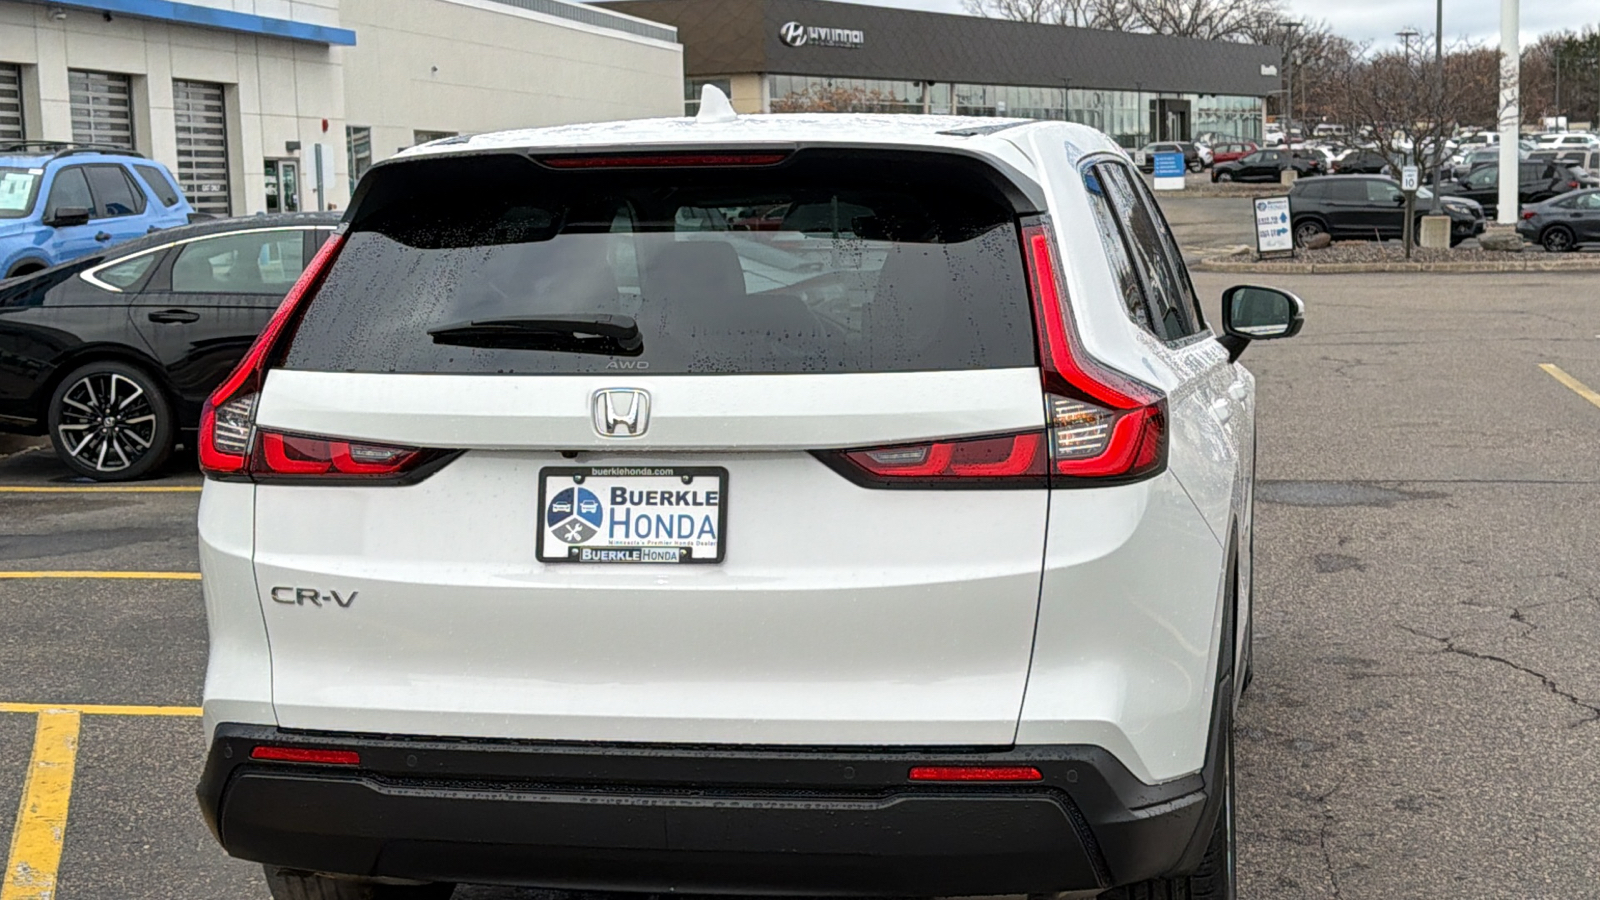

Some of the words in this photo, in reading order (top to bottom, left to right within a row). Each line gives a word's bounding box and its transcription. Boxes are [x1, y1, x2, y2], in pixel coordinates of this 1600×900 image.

[1405, 178, 1414, 188] 10
[605, 361, 649, 369] AWD
[592, 468, 674, 476] buerklehonda.com
[610, 486, 718, 506] BUERKLE
[609, 507, 716, 540] HONDA
[582, 548, 640, 561] BUERKLE
[642, 549, 677, 561] HONDA
[271, 586, 359, 608] CR-V
